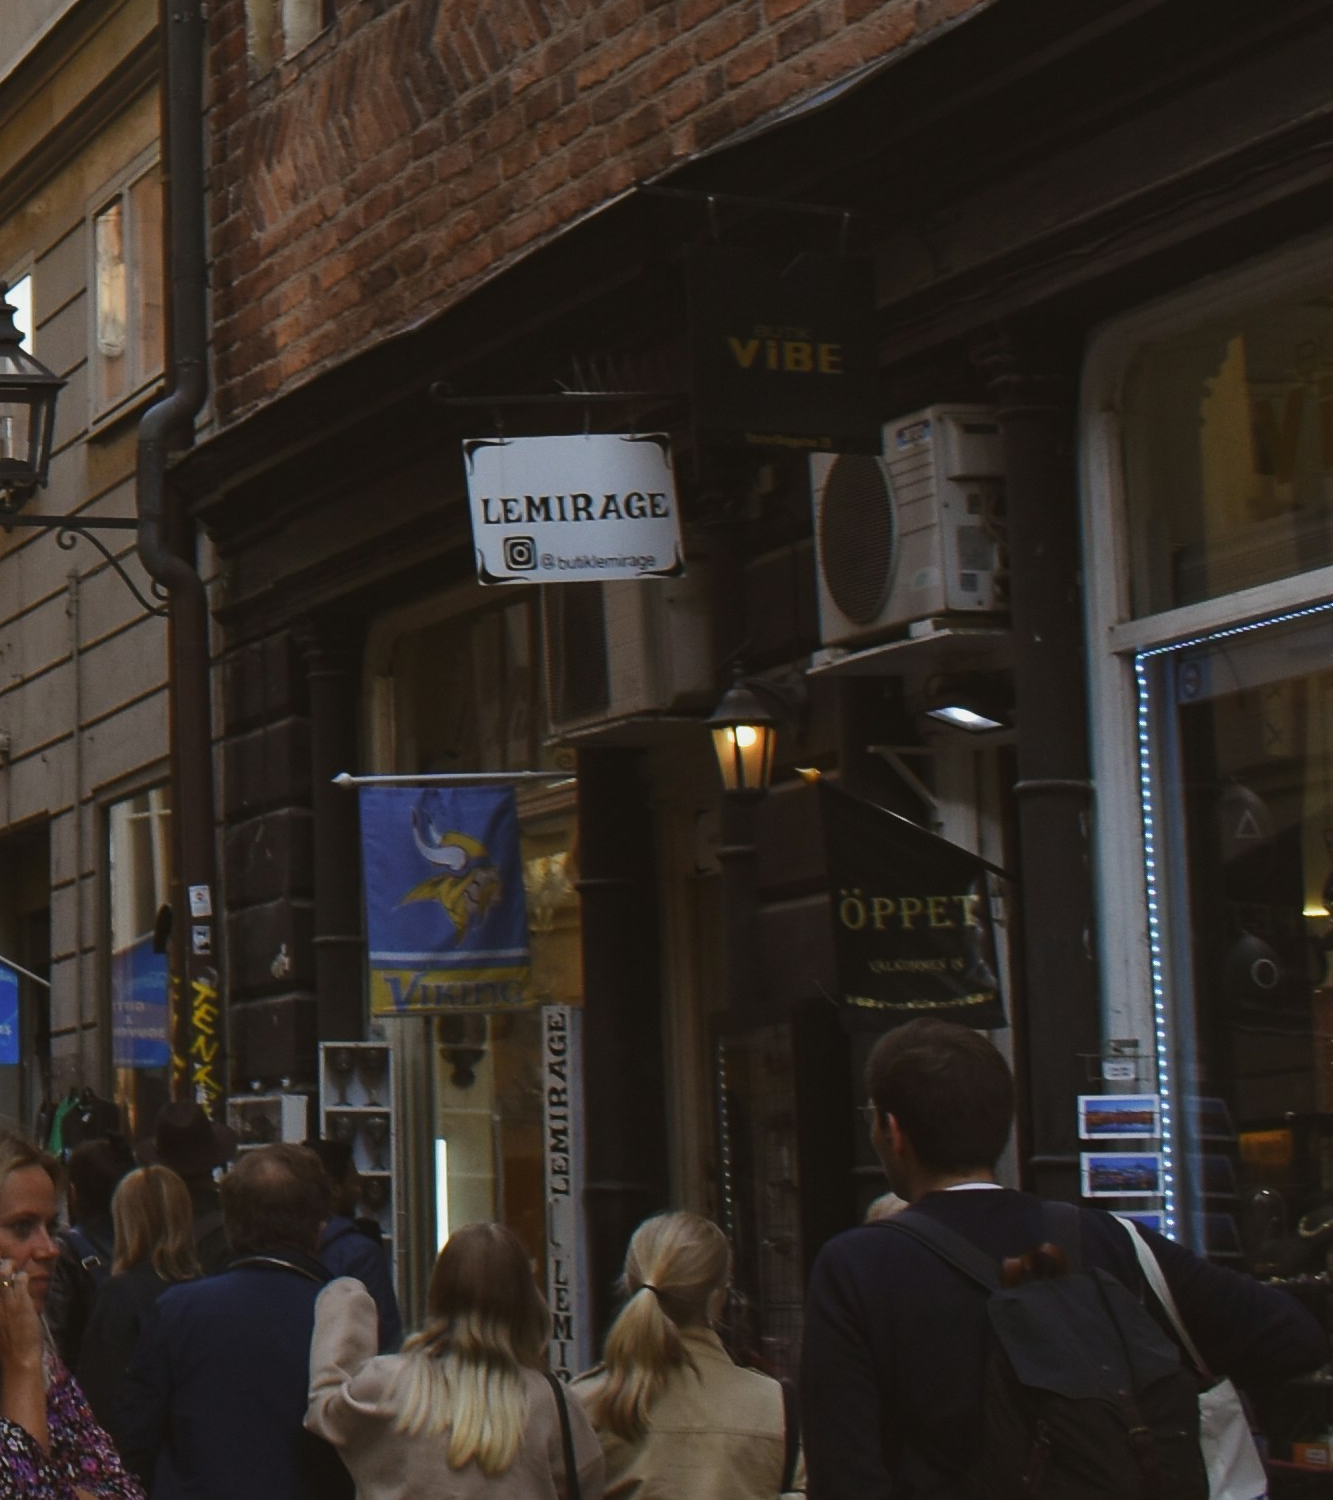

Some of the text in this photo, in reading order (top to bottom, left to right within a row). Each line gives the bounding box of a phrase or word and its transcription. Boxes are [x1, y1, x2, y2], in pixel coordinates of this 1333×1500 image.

[481, 491, 669, 525] LEMIRAGE
[839, 887, 981, 931] ÖPPET
[547, 1010, 570, 1197] LEMIRAGE
